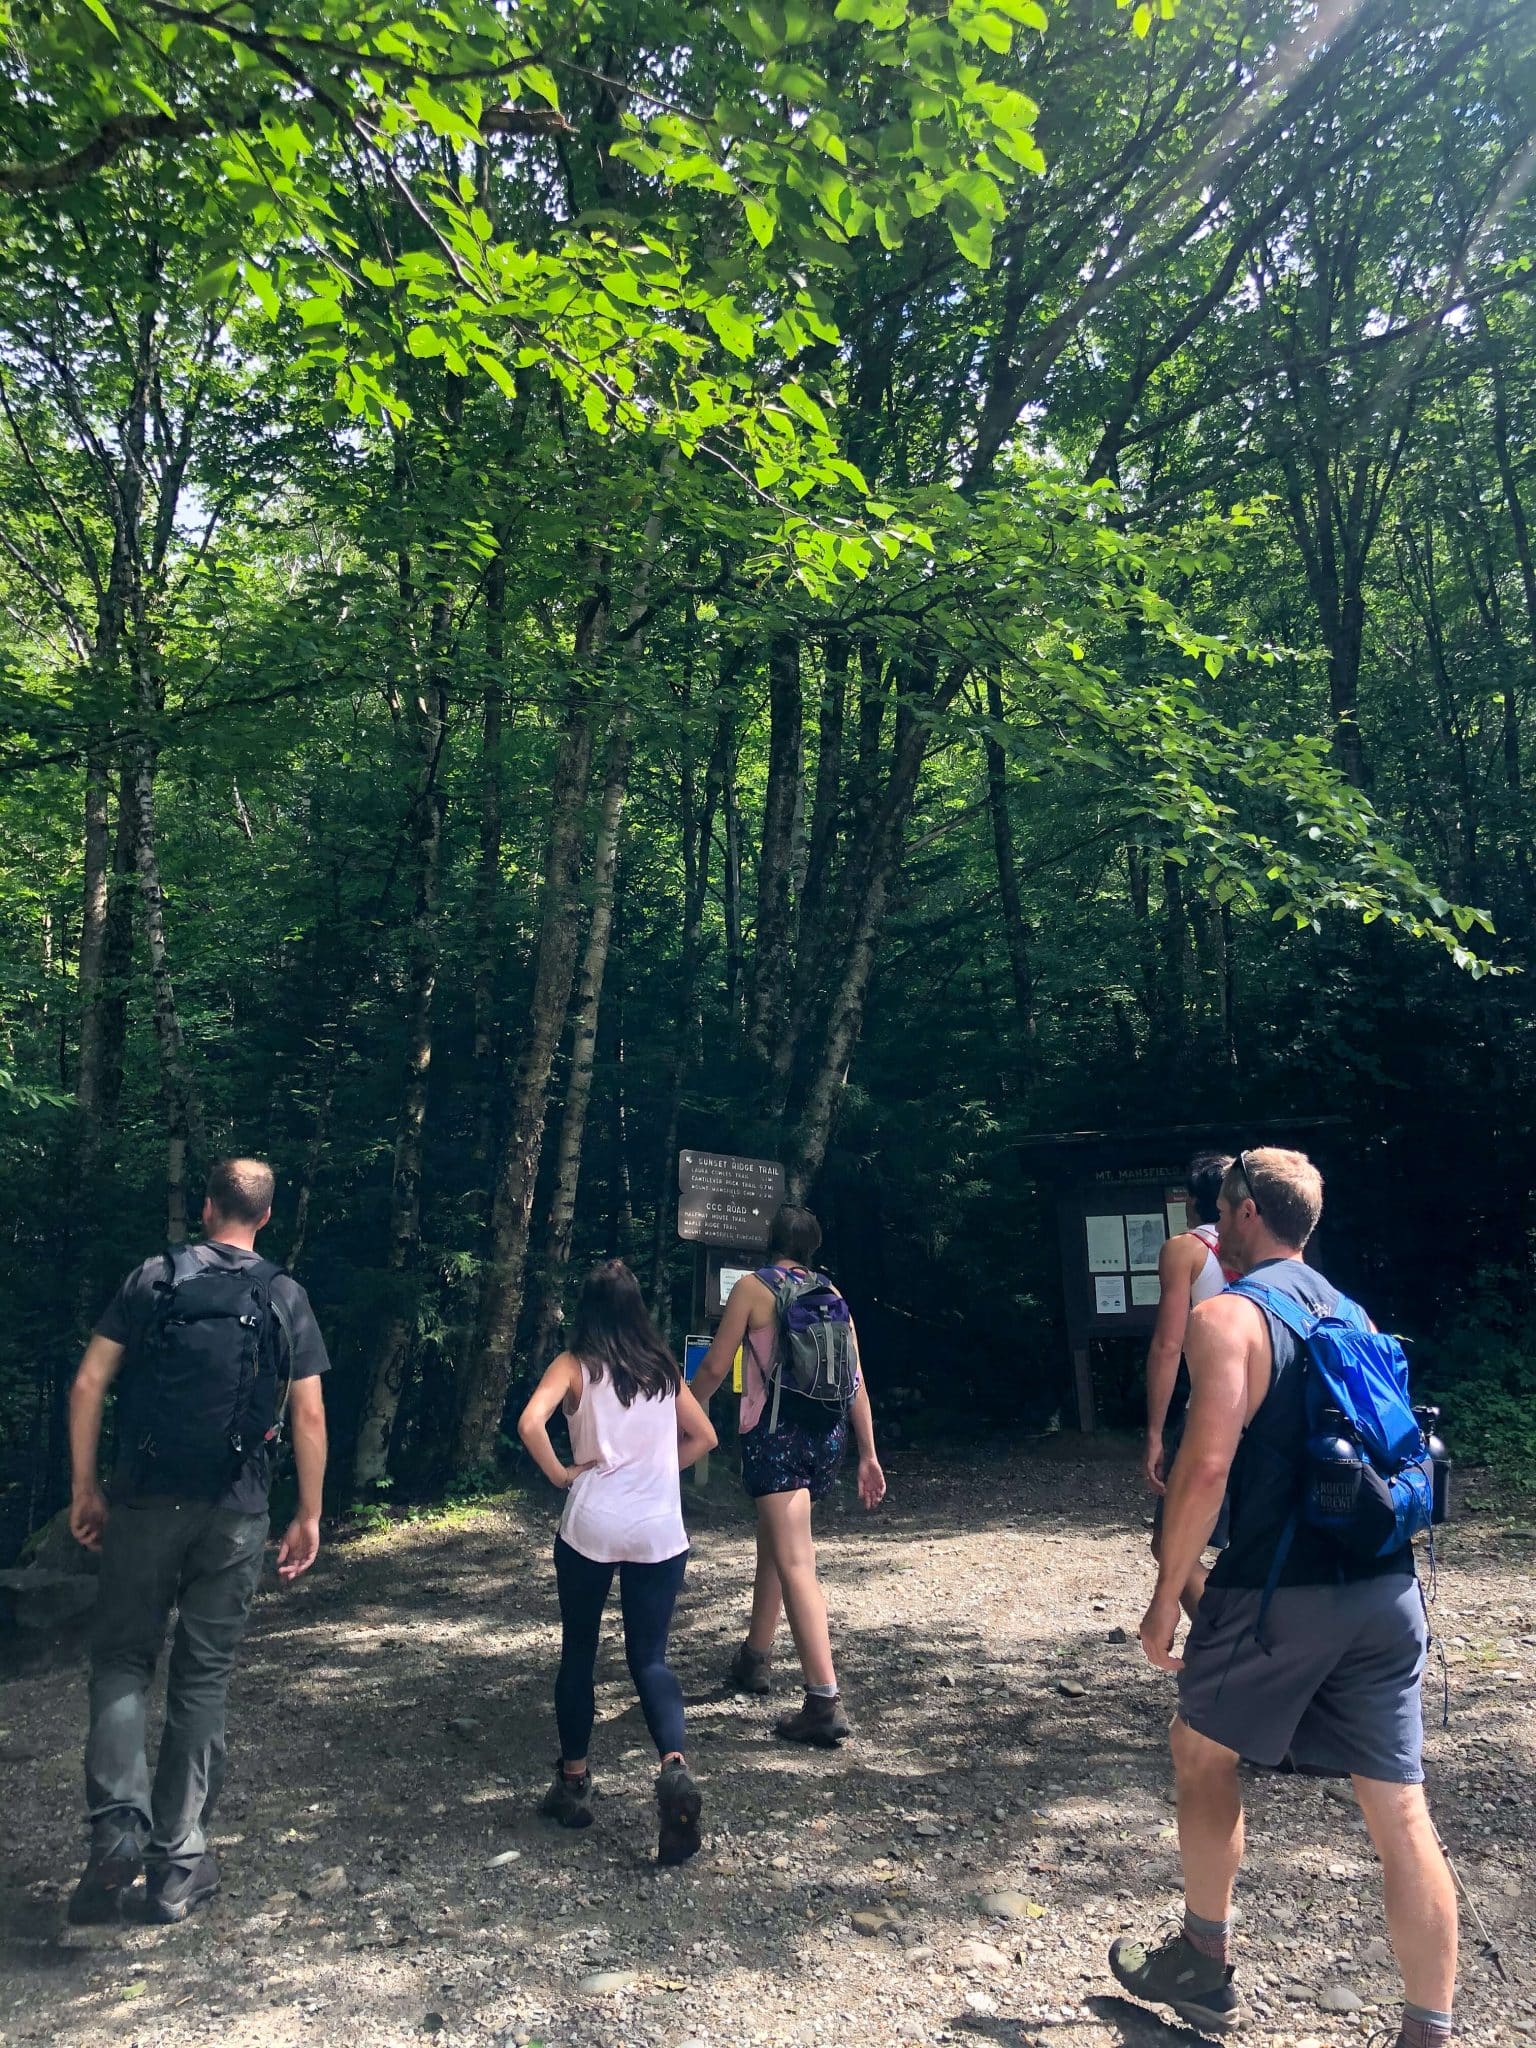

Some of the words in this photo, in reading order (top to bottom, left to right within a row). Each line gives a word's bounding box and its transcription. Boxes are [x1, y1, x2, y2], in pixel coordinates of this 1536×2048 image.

[698, 1158, 727, 1169] SUNSET
[731, 1162, 754, 1172] RIDGE
[758, 1165, 779, 1176] TRAIL
[691, 1175, 722, 1184] CANTILEVER
[711, 1187, 740, 1195] MANSFIELD
[706, 1202, 722, 1212] CCC
[726, 1204, 747, 1215] ROAD
[684, 1211, 708, 1219] HALFWAY
[711, 1213, 729, 1221] HOUSE
[732, 1215, 747, 1223] TRAIL
[704, 1230, 734, 1238] MANSFIELD
